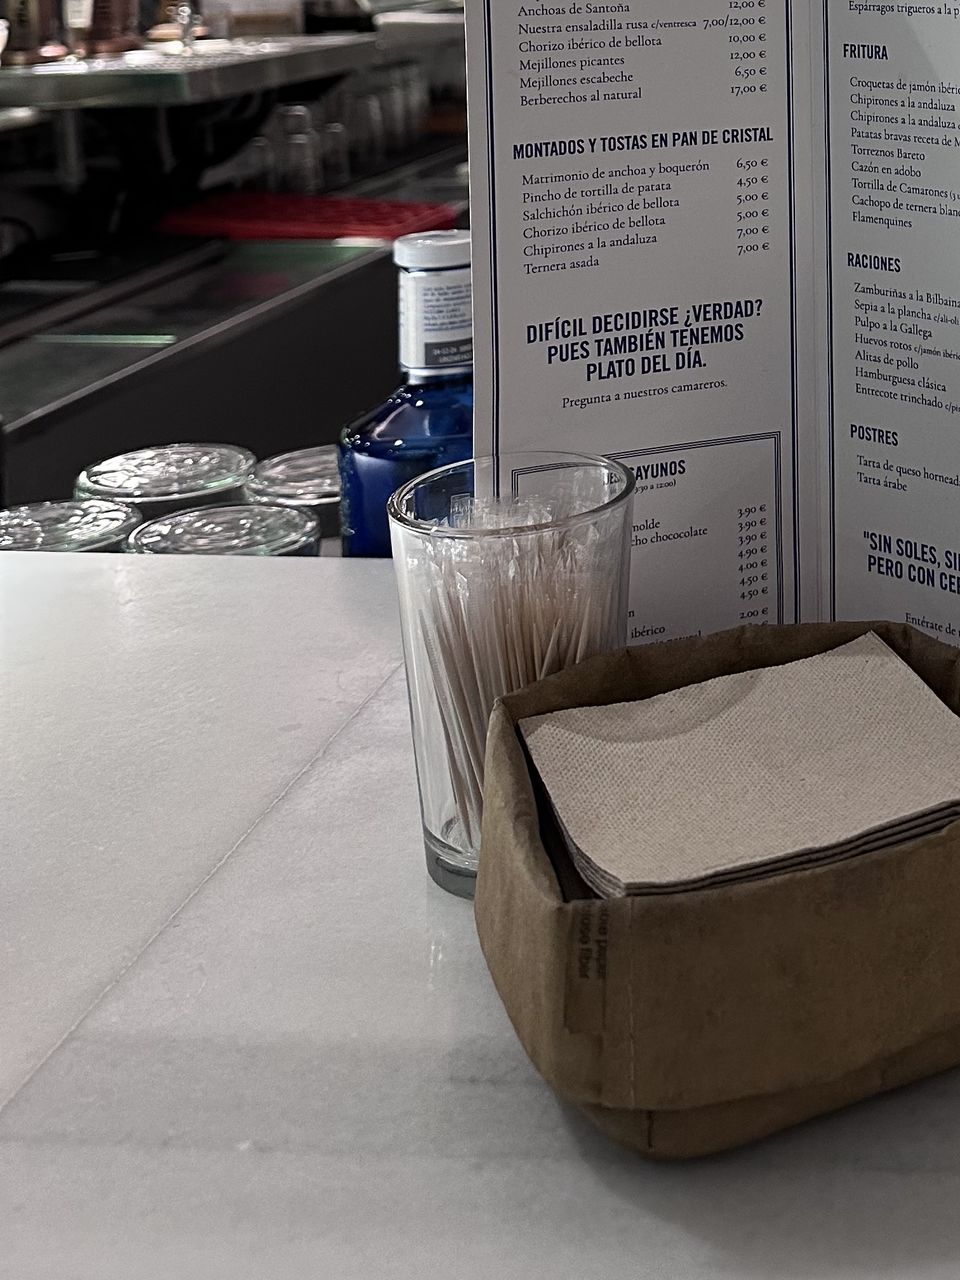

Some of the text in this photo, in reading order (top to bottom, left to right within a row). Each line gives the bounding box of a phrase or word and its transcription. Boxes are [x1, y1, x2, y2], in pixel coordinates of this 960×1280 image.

[517, 2, 630, 17] Anchoas de Santoña
[848, 0, 895, 16] Espárragos
[896, 2, 936, 17] trigueros
[936, 7, 942, 15] a
[943, 3, 952, 15] la
[518, 18, 697, 35] Nuestra ensaladilla rusa c/ventresca
[702, 14, 766, 30] 7,00/12,00 €
[518, 34, 663, 53] Chorizo ibérico de bellota
[843, 43, 889, 61] FRITURA
[519, 56, 625, 74] Mejillones picantes
[519, 70, 634, 91] Mejillones escabeche
[730, 83, 768, 97] 17,00 €
[849, 76, 895, 92] Croquetas
[895, 78, 907, 91] de
[909, 80, 936, 94] jamón
[520, 86, 642, 107] Berberechos al natural
[513, 126, 774, 160] MONTADOS Y TOSTAS EN PAN DE CRISTAL
[851, 127, 882, 140] Patatas
[883, 128, 912, 143] bravas
[913, 135, 940, 145] receta
[941, 134, 952, 147] de
[850, 143, 926, 161] Torreznos Bareto
[522, 159, 710, 186] Matrimonio de anchoa y boquerón
[851, 160, 922, 178] Cazón en adobo
[522, 196, 680, 222] Salchichón ibérico de bellota
[851, 194, 891, 212] Cachopo
[892, 197, 904, 210] de
[905, 203, 938, 214] ternera
[852, 210, 913, 230] Flamenquines
[523, 233, 658, 259] Chipirones a la andaluza
[523, 254, 600, 275] Ternera asada
[847, 252, 901, 273] RACIONES
[526, 298, 763, 345] DIFÍCIL DECIDIRSE ¿VERDAD?
[854, 315, 933, 341] Pulpo a la Gallega
[547, 323, 744, 365] PUES TAMBIÉN TENEMOS
[586, 346, 707, 382] PLATO DEL DÍA.
[854, 349, 919, 371] Alitas de pollo
[855, 366, 947, 393] Hamburguesa clásica
[562, 379, 728, 410] Pregunta a nuestros camareros.
[850, 423, 899, 447] POSTRES
[856, 454, 881, 469] Tarta
[882, 459, 894, 472] de
[895, 465, 922, 478] queso
[856, 471, 908, 492] Tarta árabe
[863, 530, 892, 555] "SIN
[895, 538, 941, 569] SOLES,
[867, 554, 904, 580] PERO
[907, 563, 935, 588] CON
[631, 625, 666, 639] ibérico
[904, 611, 944, 633] Entérate
[945, 622, 957, 636] de
